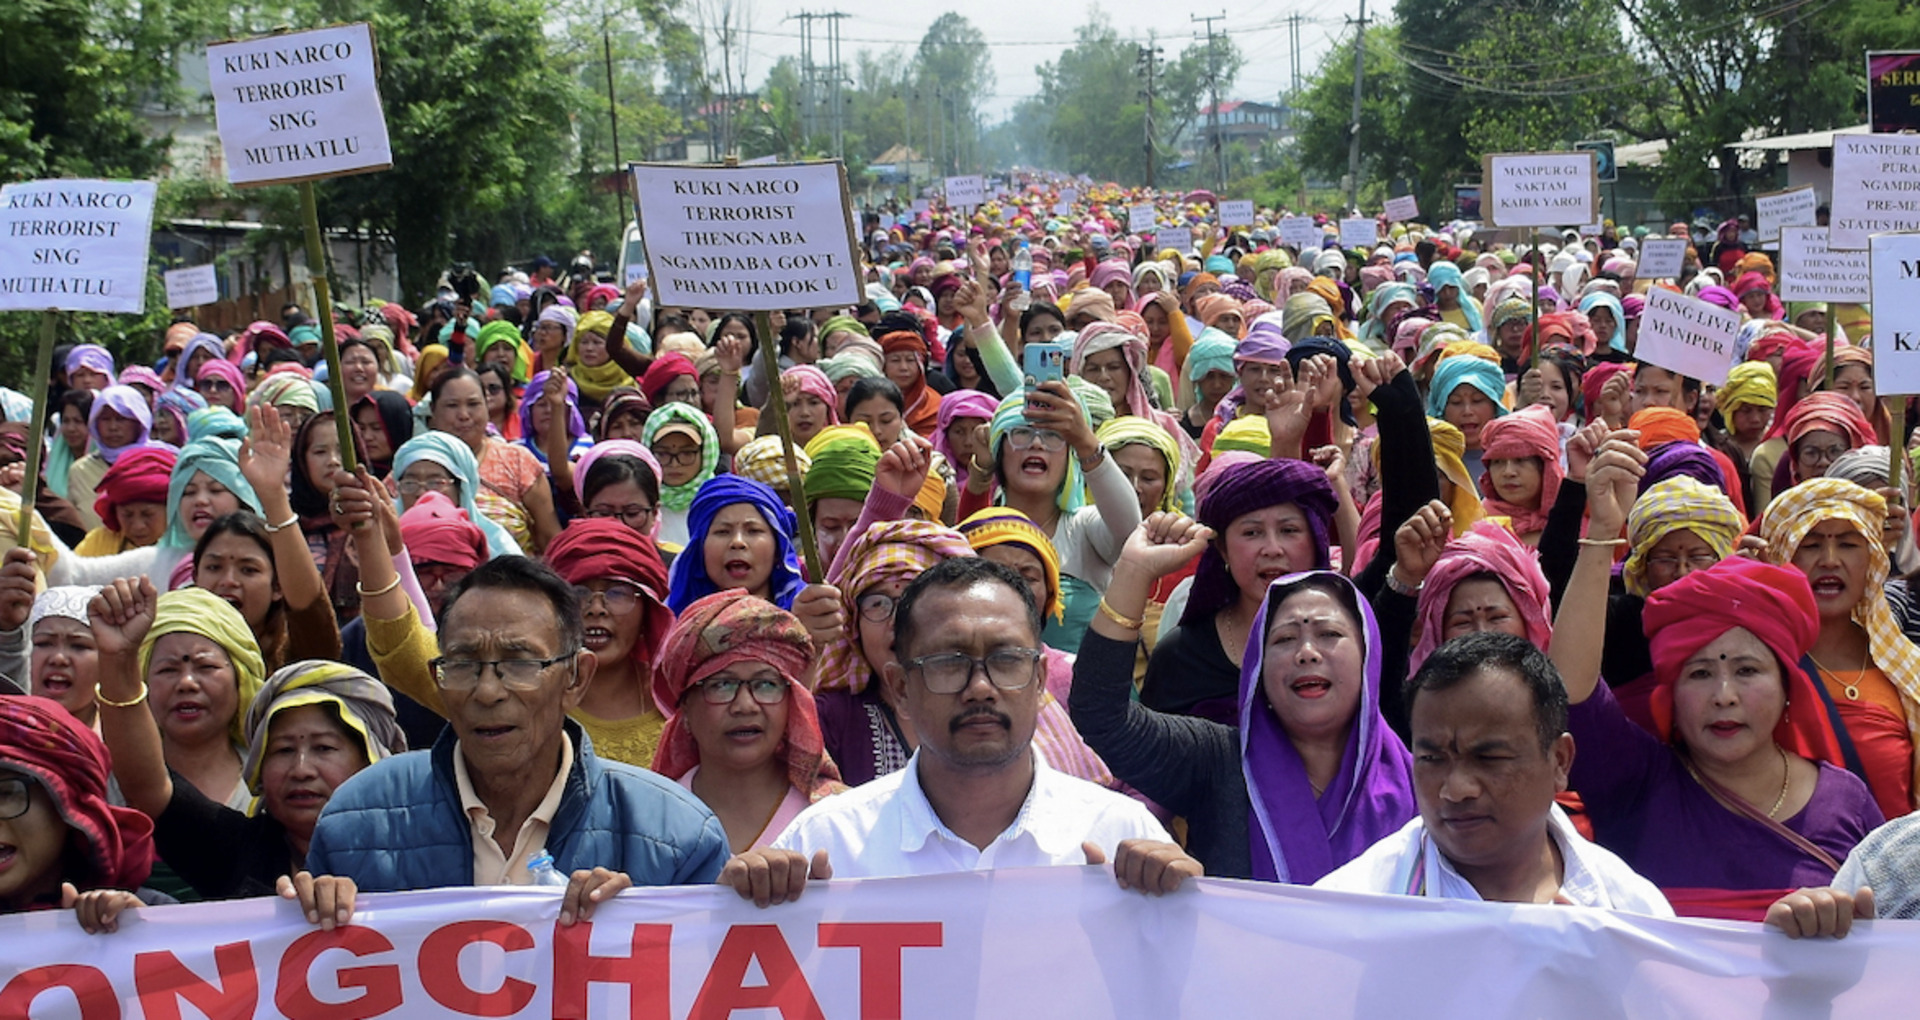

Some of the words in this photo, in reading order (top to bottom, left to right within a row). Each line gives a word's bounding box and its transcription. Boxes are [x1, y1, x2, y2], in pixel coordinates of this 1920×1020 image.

[224, 53, 269, 73] KUKI
[275, 41, 352, 67] NARCO
[233, 73, 347, 103] TERRORIST
[268, 110, 317, 132] SING
[245, 136, 359, 165] MUTHATLU
[1847, 144, 1911, 156] MANIPUR
[1504, 166, 1561, 176] MANIPUR
[1564, 165, 1578, 175] GI
[1881, 162, 1920, 174] PURA
[674, 180, 722, 195] KUKI
[727, 179, 800, 196] NARCO
[1515, 181, 1567, 191] SAKTAM
[8, 192, 52, 209] KUKI
[58, 191, 132, 209] NARCO
[1501, 197, 1539, 208] KAIBA
[1543, 196, 1582, 207] YAROI
[1867, 200, 1920, 212] PRE-ME
[683, 205, 795, 221] TERRORIST
[9, 220, 120, 237] TERRORIST
[1839, 219, 1890, 230] STATUS
[681, 231, 807, 246] THENGNABA
[32, 248, 81, 265] SING
[660, 255, 773, 271] NGAMDABA
[778, 254, 842, 270] GOVT.
[1803, 259, 1866, 268] THENGNABA
[1787, 271, 1847, 281] NGAMDABA
[1, 277, 113, 296] MUTHATLU
[673, 278, 729, 295] PHAM
[731, 279, 819, 295] THADOK
[824, 277, 838, 291] U
[1790, 285, 1821, 293] PHAM
[1824, 286, 1867, 295] THADOK
[1649, 294, 1694, 320] LONG
[1697, 311, 1737, 336] LIVE
[1650, 318, 1724, 355] MANIPUR
